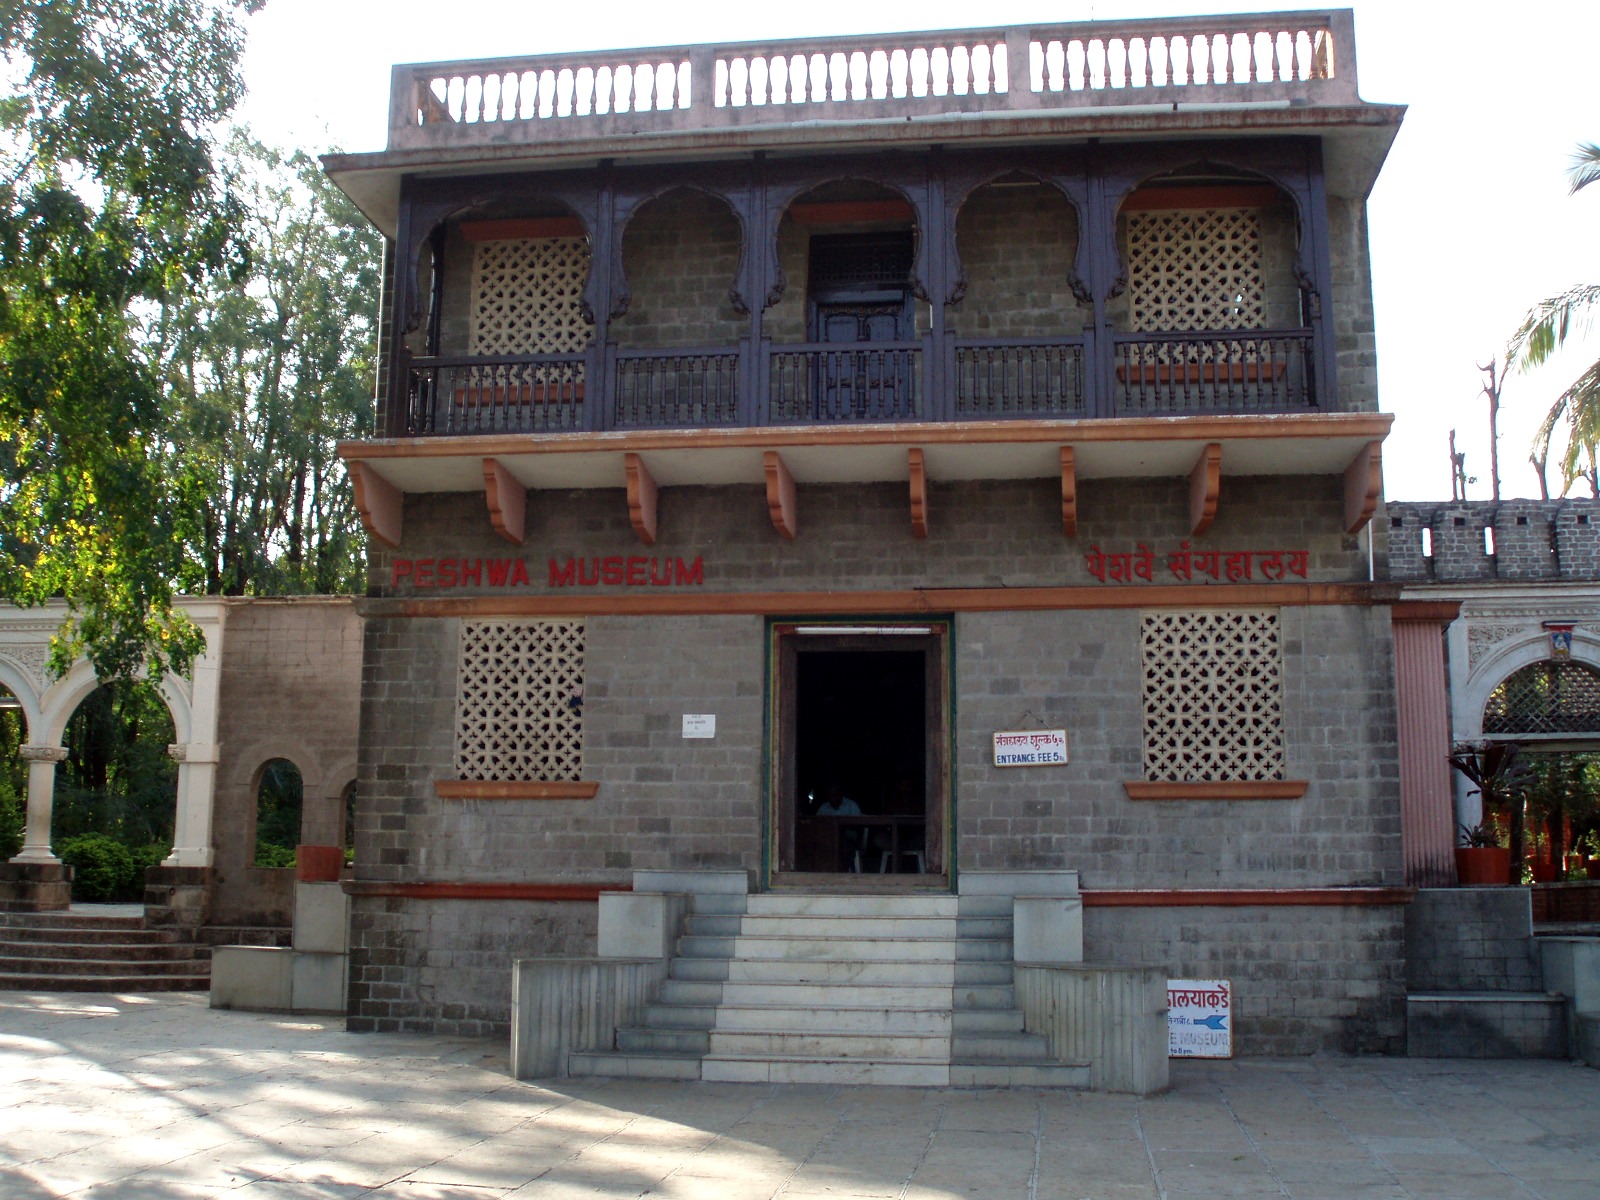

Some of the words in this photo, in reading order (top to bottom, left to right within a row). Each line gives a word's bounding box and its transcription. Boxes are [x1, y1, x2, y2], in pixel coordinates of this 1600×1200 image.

[391, 558, 530, 588] PESHWA
[549, 555, 704, 587] MUSEUM
[1084, 543, 1155, 583] पेशवे
[1167, 540, 1310, 583] संग्रहालय
[996, 753, 1036, 764] ENTRANCE
[1037, 752, 1052, 762] FEE
[1053, 752, 1059, 762] 5
[1180, 1032, 1229, 1046] MUSEUM
